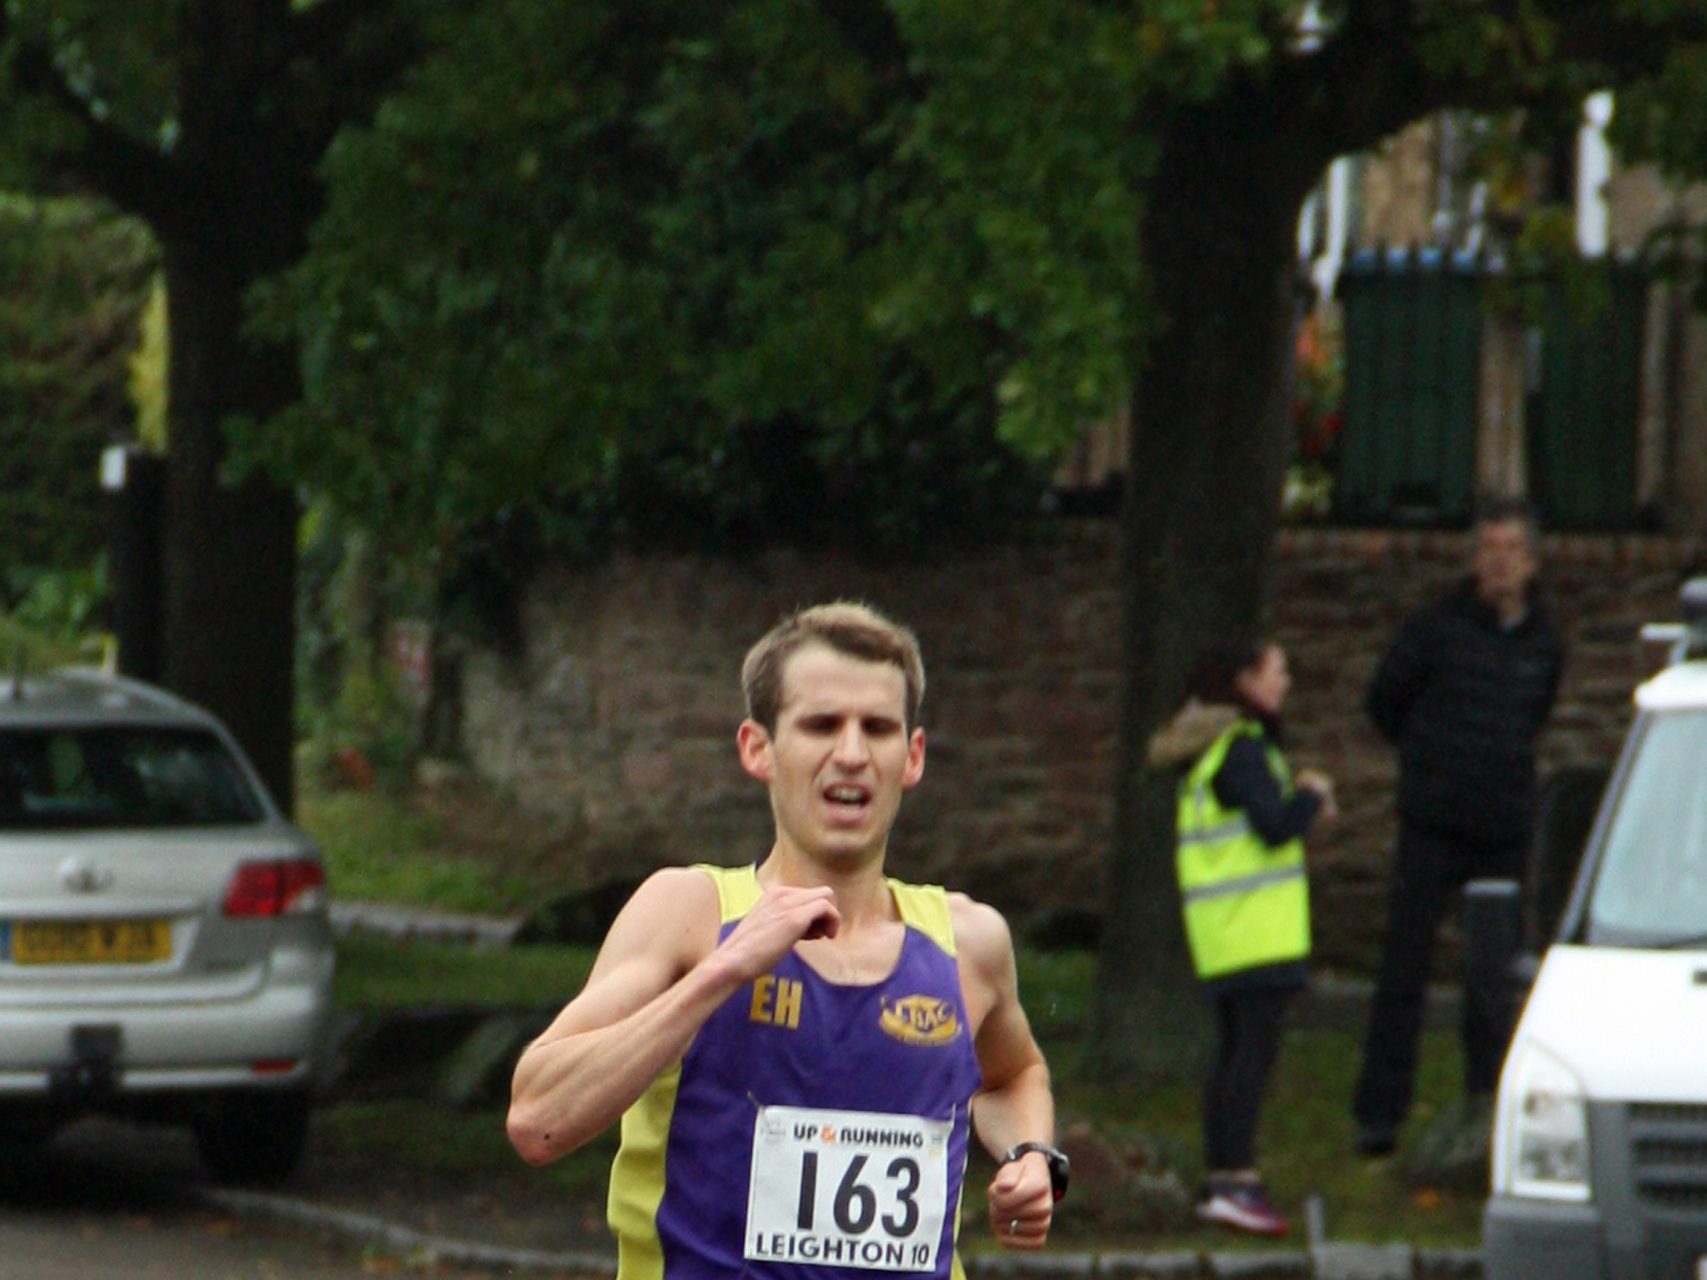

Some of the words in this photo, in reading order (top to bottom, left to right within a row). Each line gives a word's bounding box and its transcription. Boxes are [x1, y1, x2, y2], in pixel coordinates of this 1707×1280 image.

[750, 975, 803, 1029] EH
[794, 1122, 817, 1140] UP
[840, 1127, 923, 1147] RUNNING
[797, 1152, 921, 1237] 163
[757, 1233, 904, 1265] LEIGHTON
[912, 1244, 930, 1266] 10
